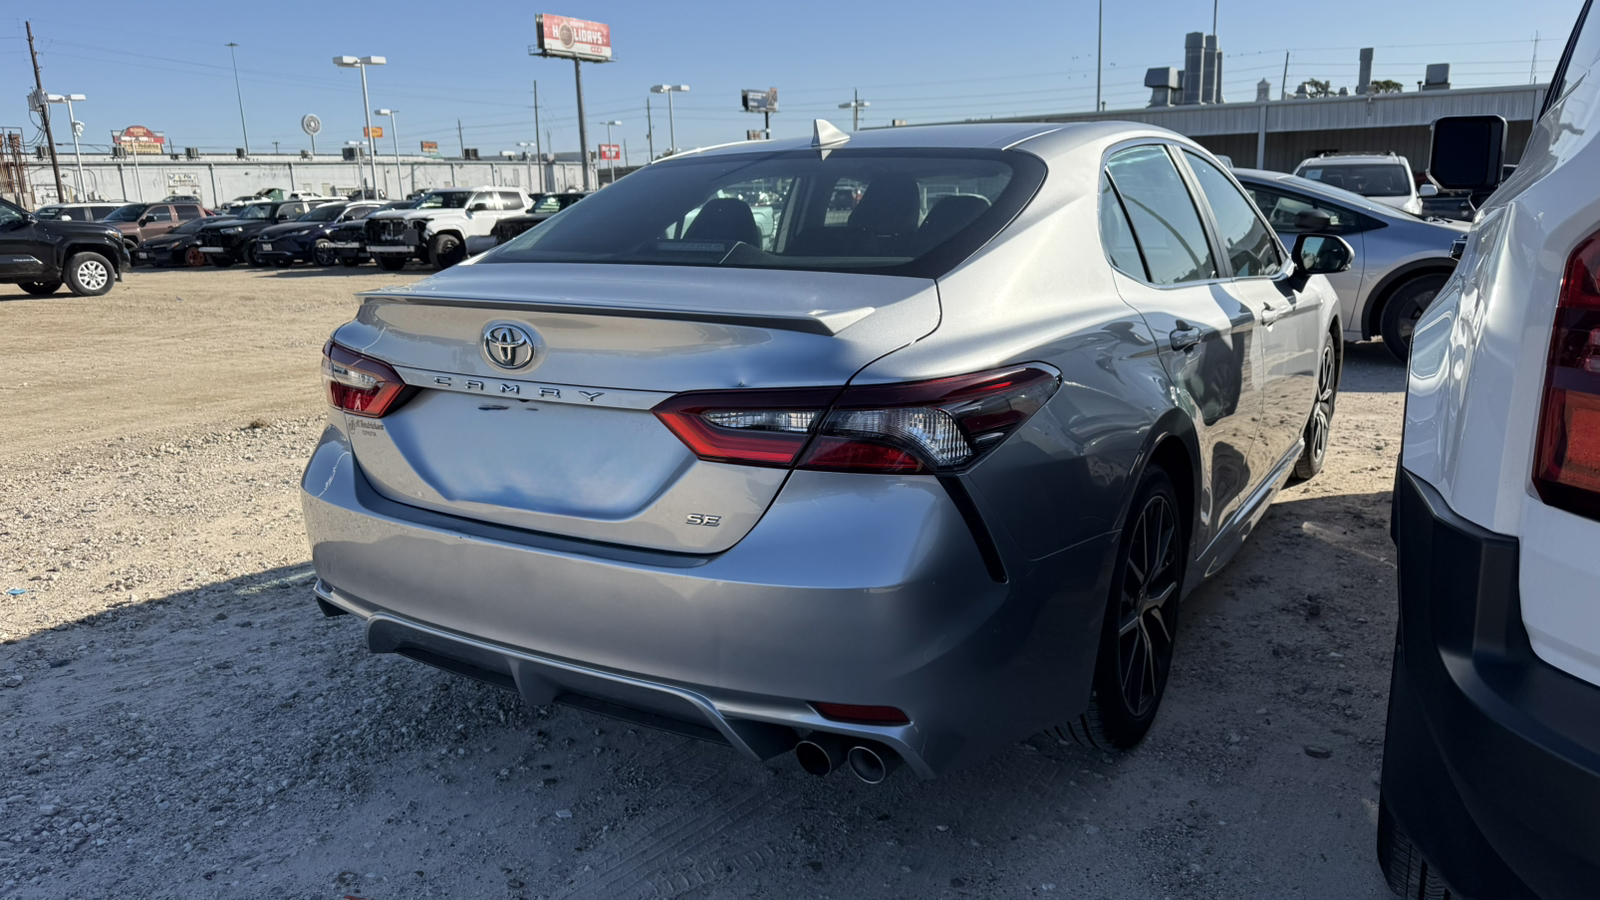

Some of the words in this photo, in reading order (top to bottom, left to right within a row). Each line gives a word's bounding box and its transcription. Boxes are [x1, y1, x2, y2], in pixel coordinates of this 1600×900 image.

[434, 375, 605, 402] CAMRY
[361, 429, 377, 437] TOYOTA
[685, 512, 722, 527] SE
